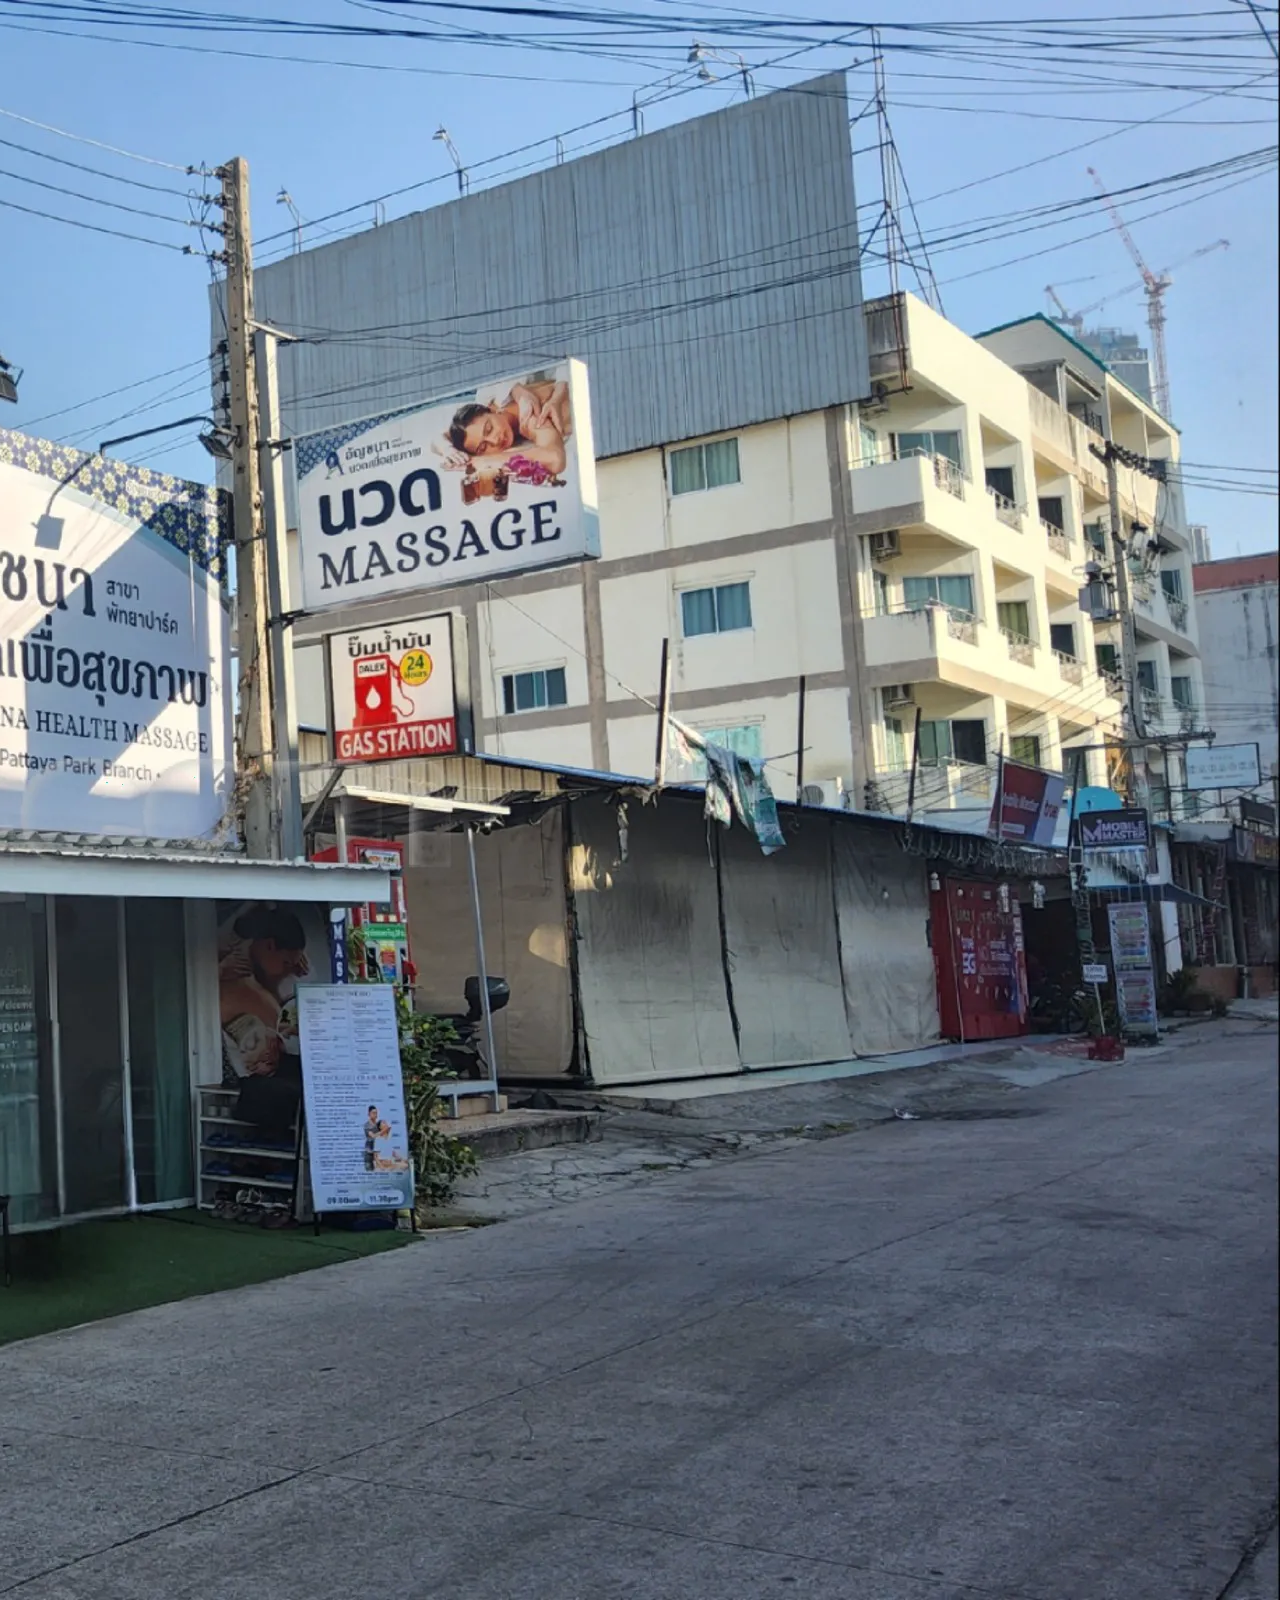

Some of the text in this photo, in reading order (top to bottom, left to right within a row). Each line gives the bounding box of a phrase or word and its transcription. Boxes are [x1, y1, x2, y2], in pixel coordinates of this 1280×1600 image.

[319, 467, 443, 537] นวด
[318, 499, 562, 590] MASSAGE
[105, 577, 140, 601] สาขา
[347, 628, 432, 658] ปั๊มน้ำมัน
[407, 654, 425, 671] 24
[35, 710, 119, 743] HEALTH
[123, 721, 209, 754] MASSAGE
[340, 724, 452, 758] GAS STATION
[0, 748, 153, 782] Pattaya Park Branch
[1102, 820, 1146, 832] MOBILE
[1102, 830, 1148, 842] MASTER
